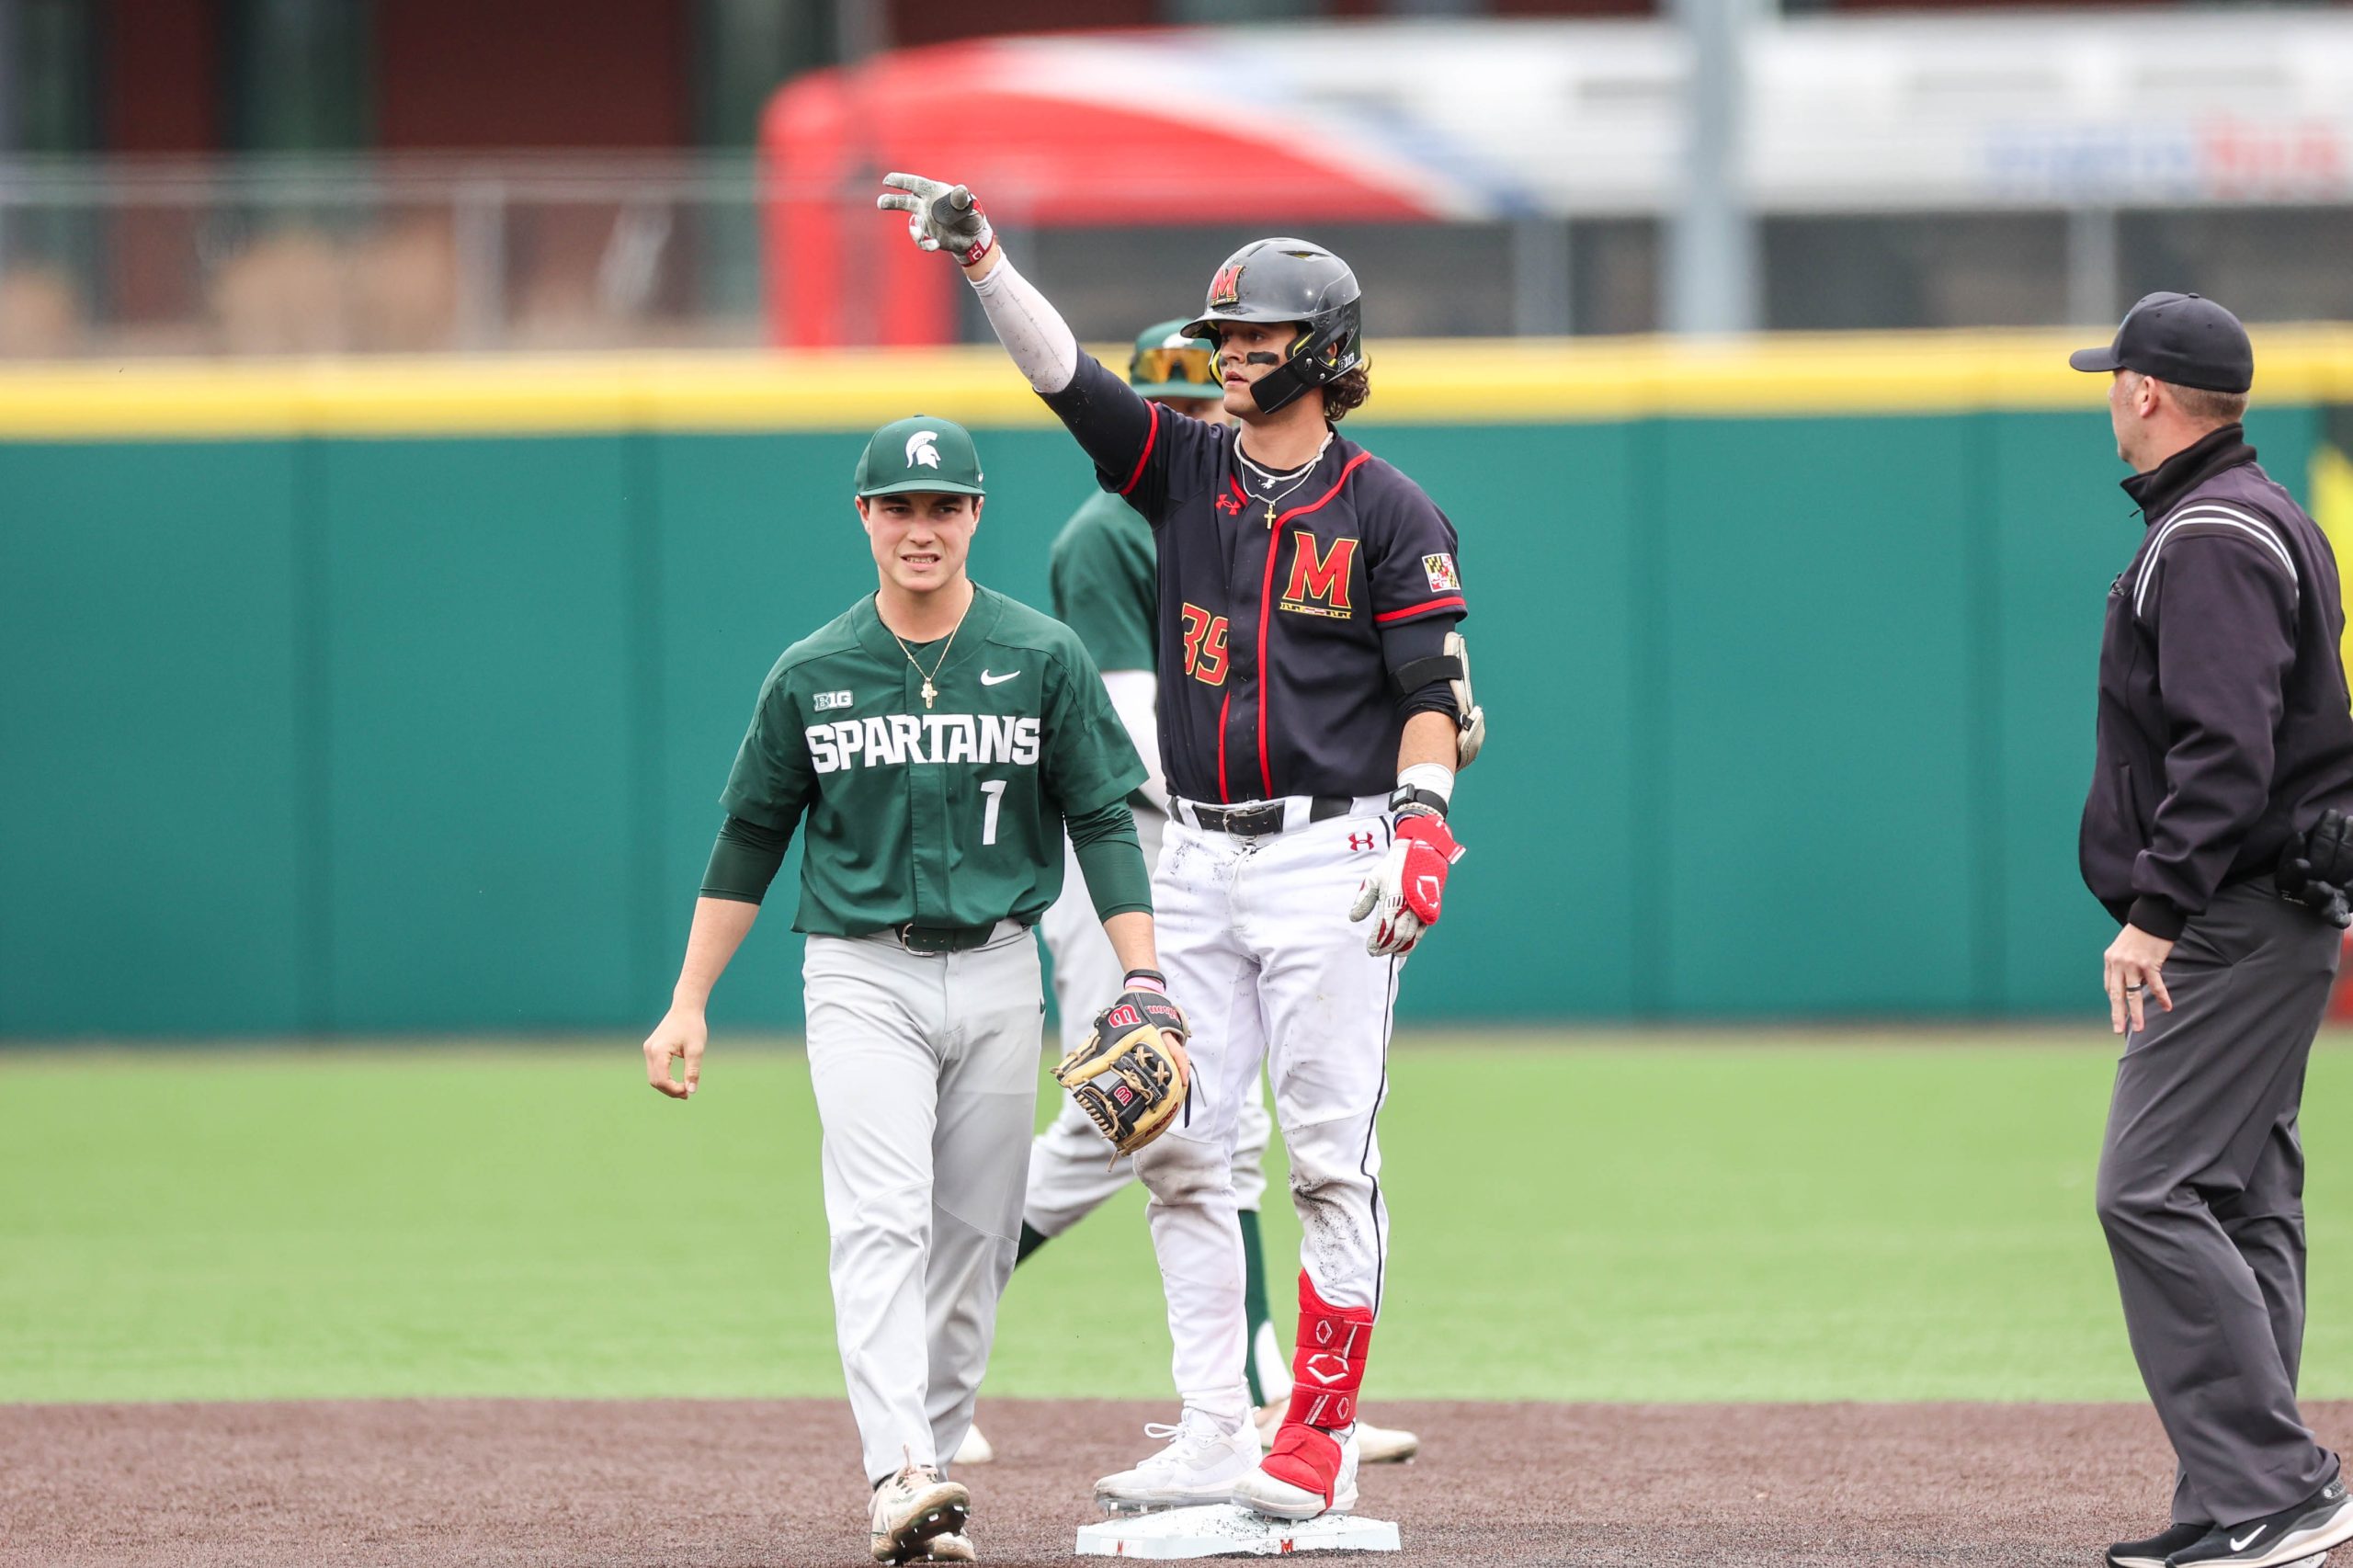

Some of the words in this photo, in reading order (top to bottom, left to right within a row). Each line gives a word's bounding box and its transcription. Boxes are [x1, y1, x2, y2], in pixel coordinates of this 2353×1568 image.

[1211, 265, 1245, 301] M
[1282, 531, 1358, 609] M
[805, 714, 1041, 774] SPARTANS
[980, 779, 1007, 846] 1
[1280, 1539, 1294, 1554] M
